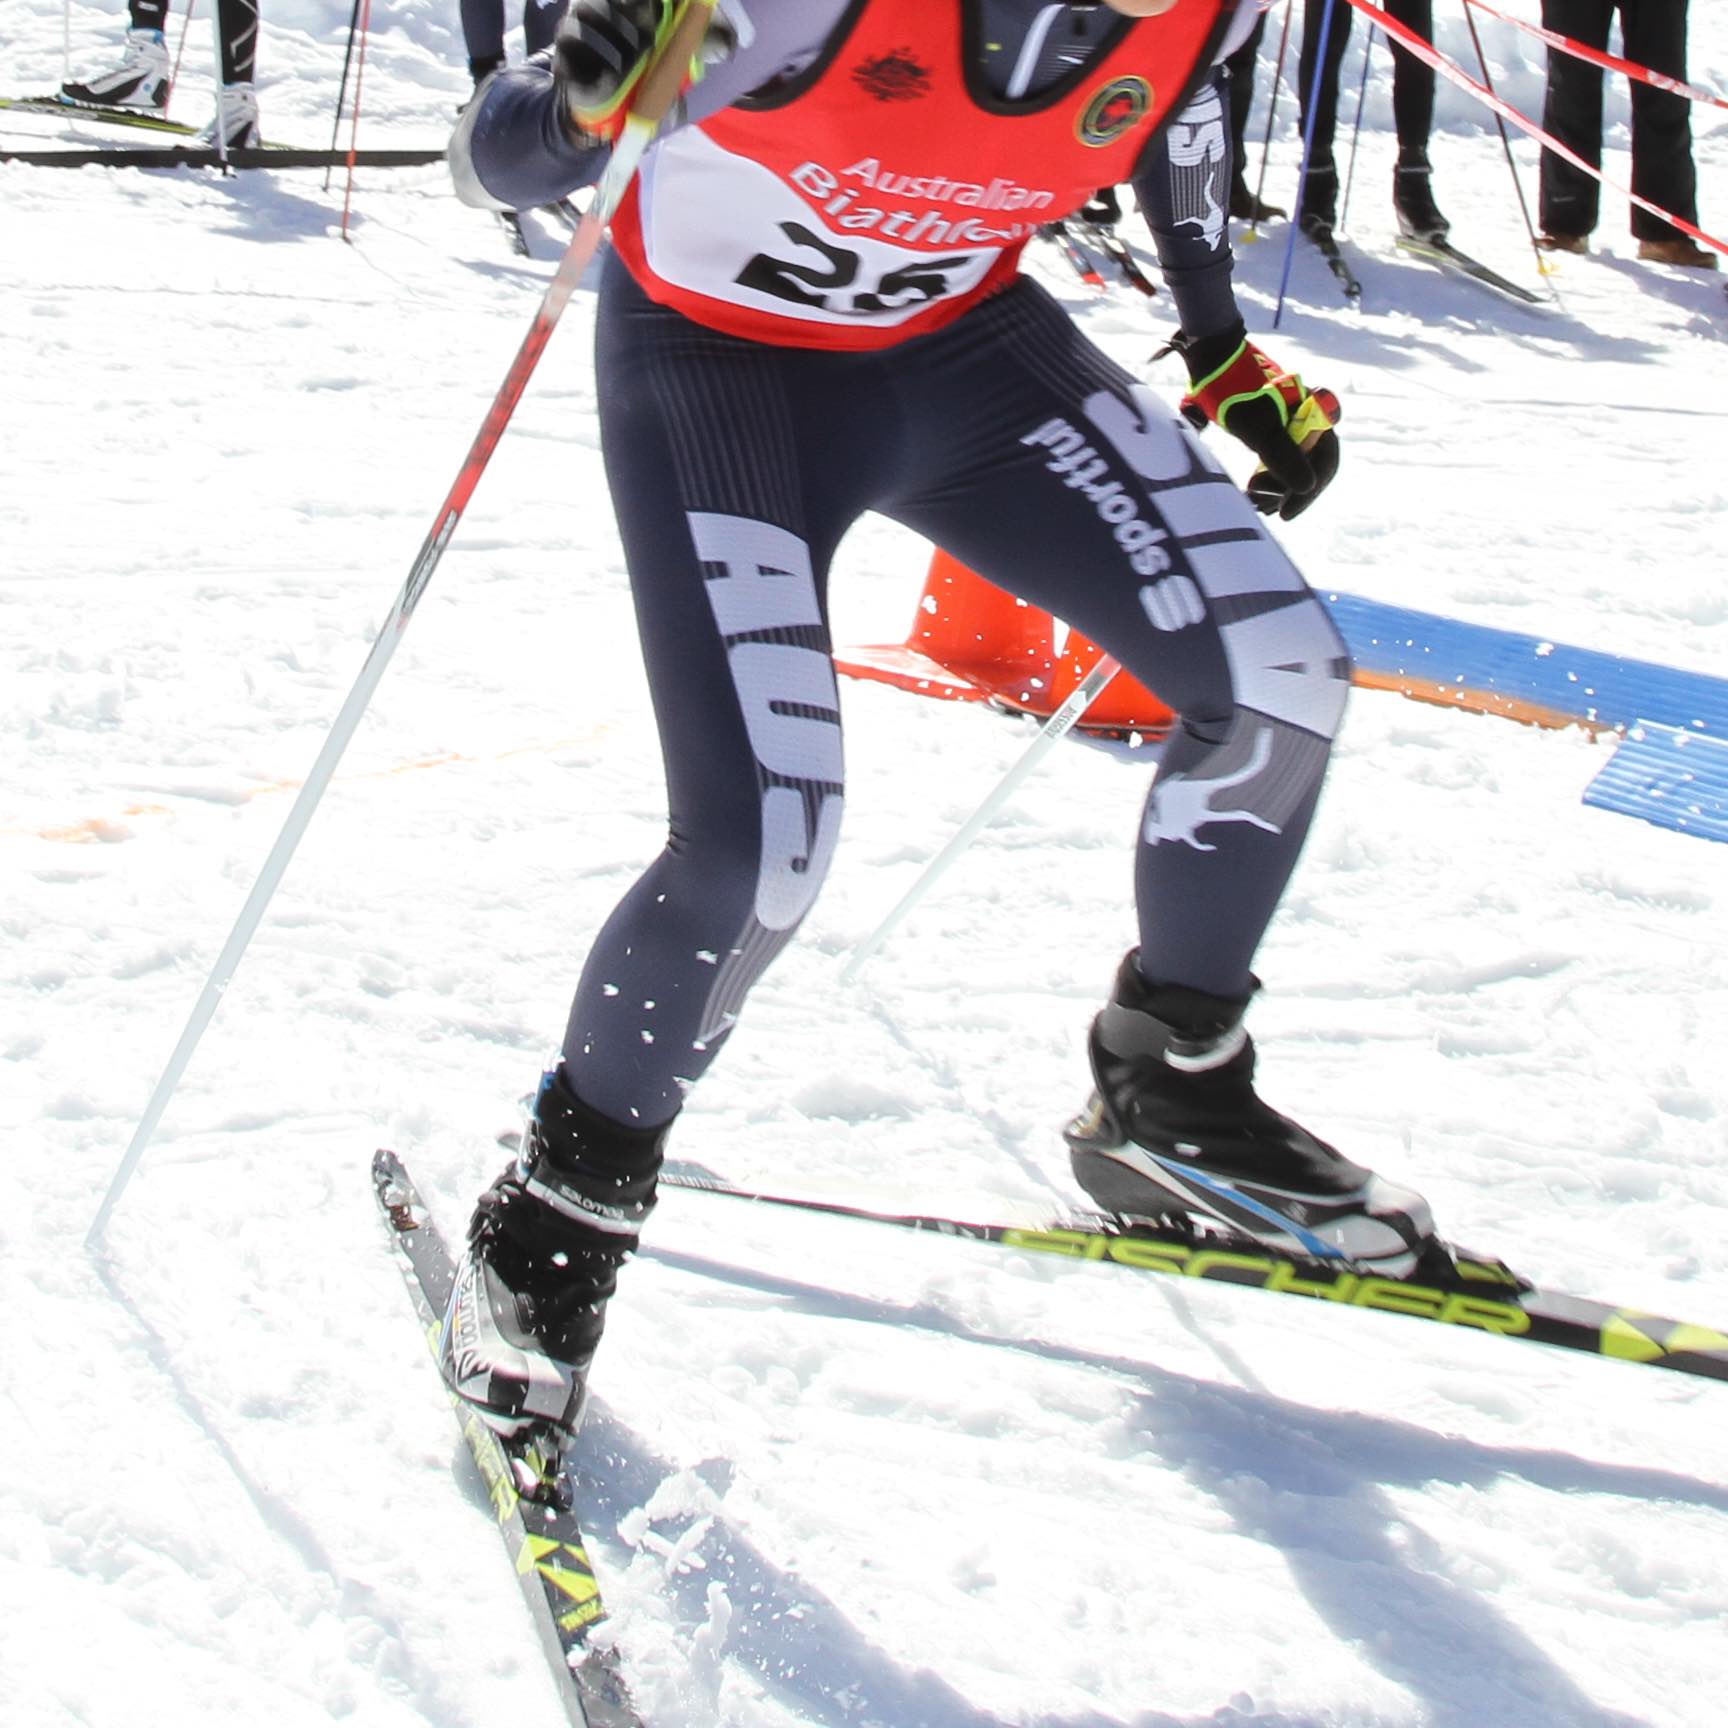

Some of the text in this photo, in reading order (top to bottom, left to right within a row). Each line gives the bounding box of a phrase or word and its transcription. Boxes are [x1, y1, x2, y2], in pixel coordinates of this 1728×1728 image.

[840, 157, 1057, 212] Australian
[1020, 415, 1177, 578] sportful
[685, 509, 846, 931] AUS
